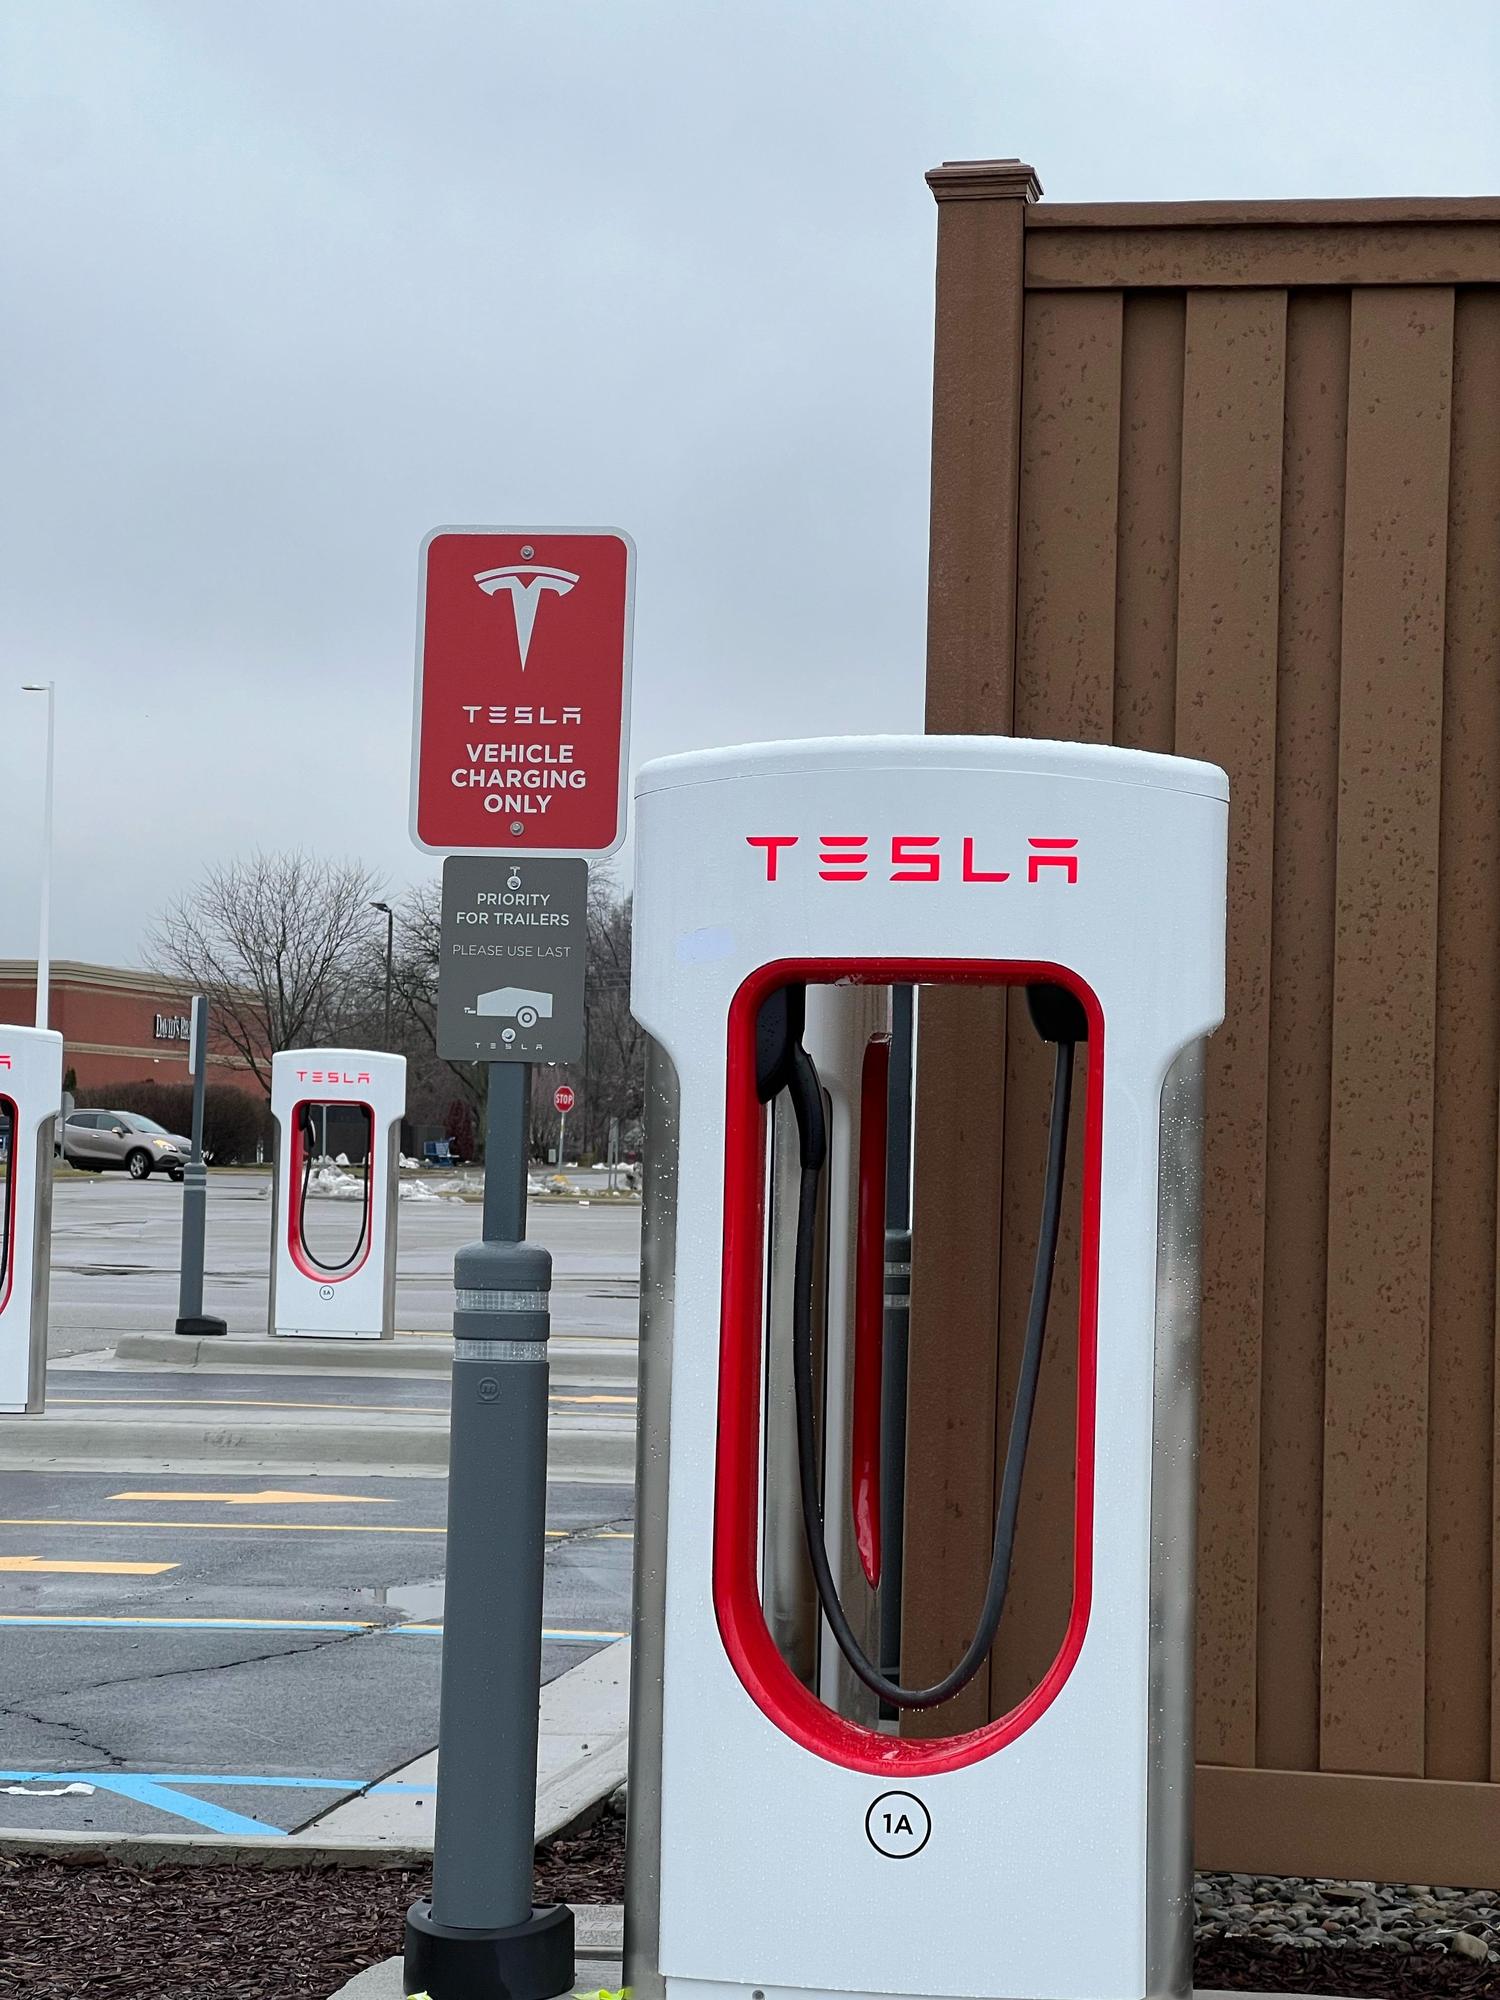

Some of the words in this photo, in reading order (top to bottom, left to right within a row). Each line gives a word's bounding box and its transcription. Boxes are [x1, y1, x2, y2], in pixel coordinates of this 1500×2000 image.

[462, 705, 582, 725] TESLA
[466, 743, 574, 764] VEHICLE
[451, 768, 587, 789] CHARGING
[483, 793, 552, 813] ONLY
[745, 836, 1079, 884] TESLA
[476, 892, 551, 906] PRIORITY
[456, 911, 489, 925] FOR
[493, 912, 570, 926] TRAILERS
[452, 944, 504, 956] PLEASE
[507, 945, 534, 957] USE
[537, 946, 571, 958] LAST
[474, 1042, 543, 1050] TESLA
[296, 1071, 370, 1084] TESLA
[556, 1093, 573, 1104] STOP
[883, 1813, 914, 1836] 1A
